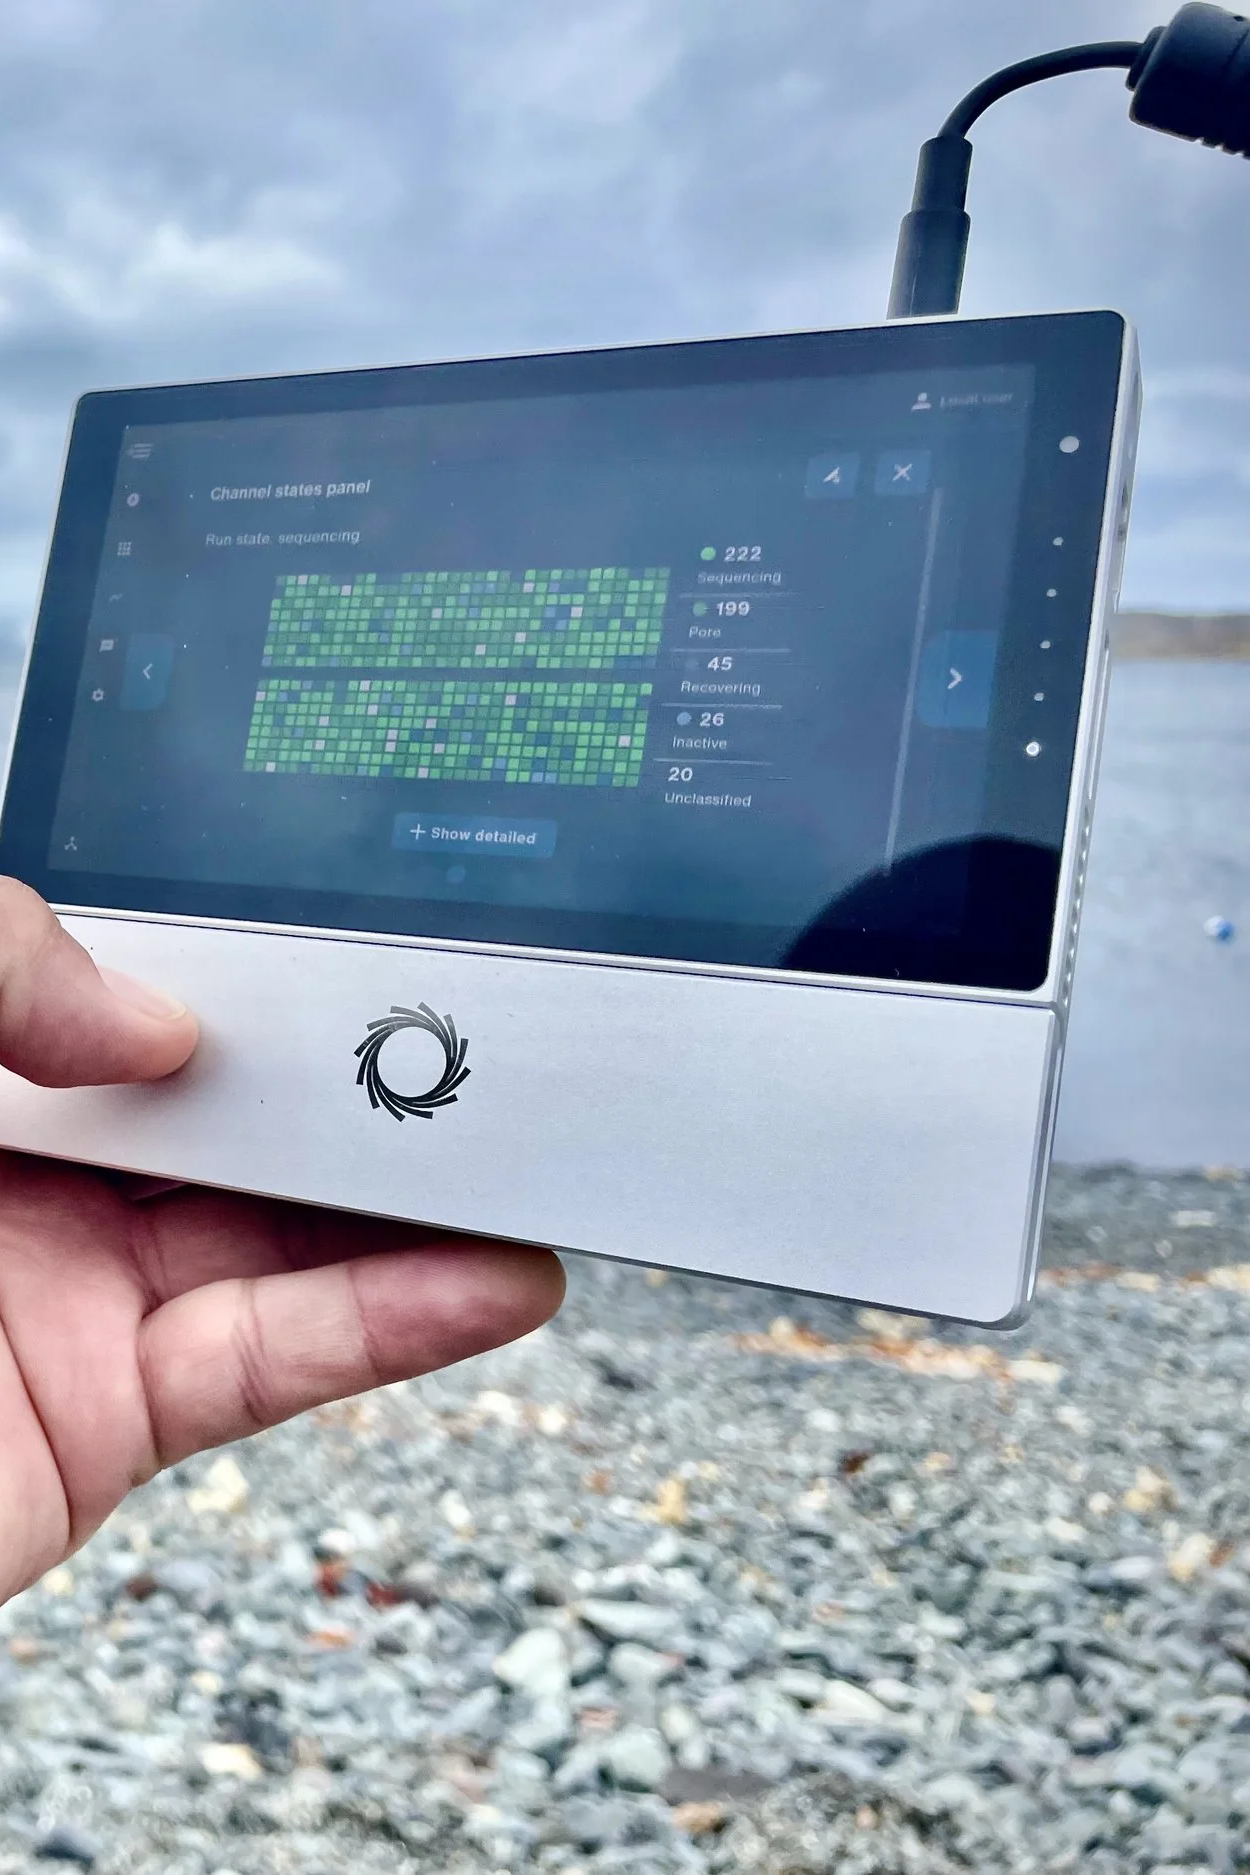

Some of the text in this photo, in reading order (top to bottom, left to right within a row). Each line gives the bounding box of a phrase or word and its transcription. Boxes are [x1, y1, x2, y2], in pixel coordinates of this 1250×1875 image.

[210, 479, 372, 501] Channel states panel
[205, 533, 232, 546] Run
[278, 530, 361, 546] sequencing
[724, 546, 762, 562] 222
[697, 571, 782, 586] Sequencing
[716, 601, 750, 616] 199
[689, 626, 721, 638] Pore
[707, 656, 733, 671] 45
[681, 680, 761, 697] Recovering
[699, 712, 725, 727] 26
[672, 735, 727, 749] Inactive
[668, 767, 693, 782] 20
[664, 792, 752, 807] Unclassified
[431, 827, 538, 845] Show detailed
